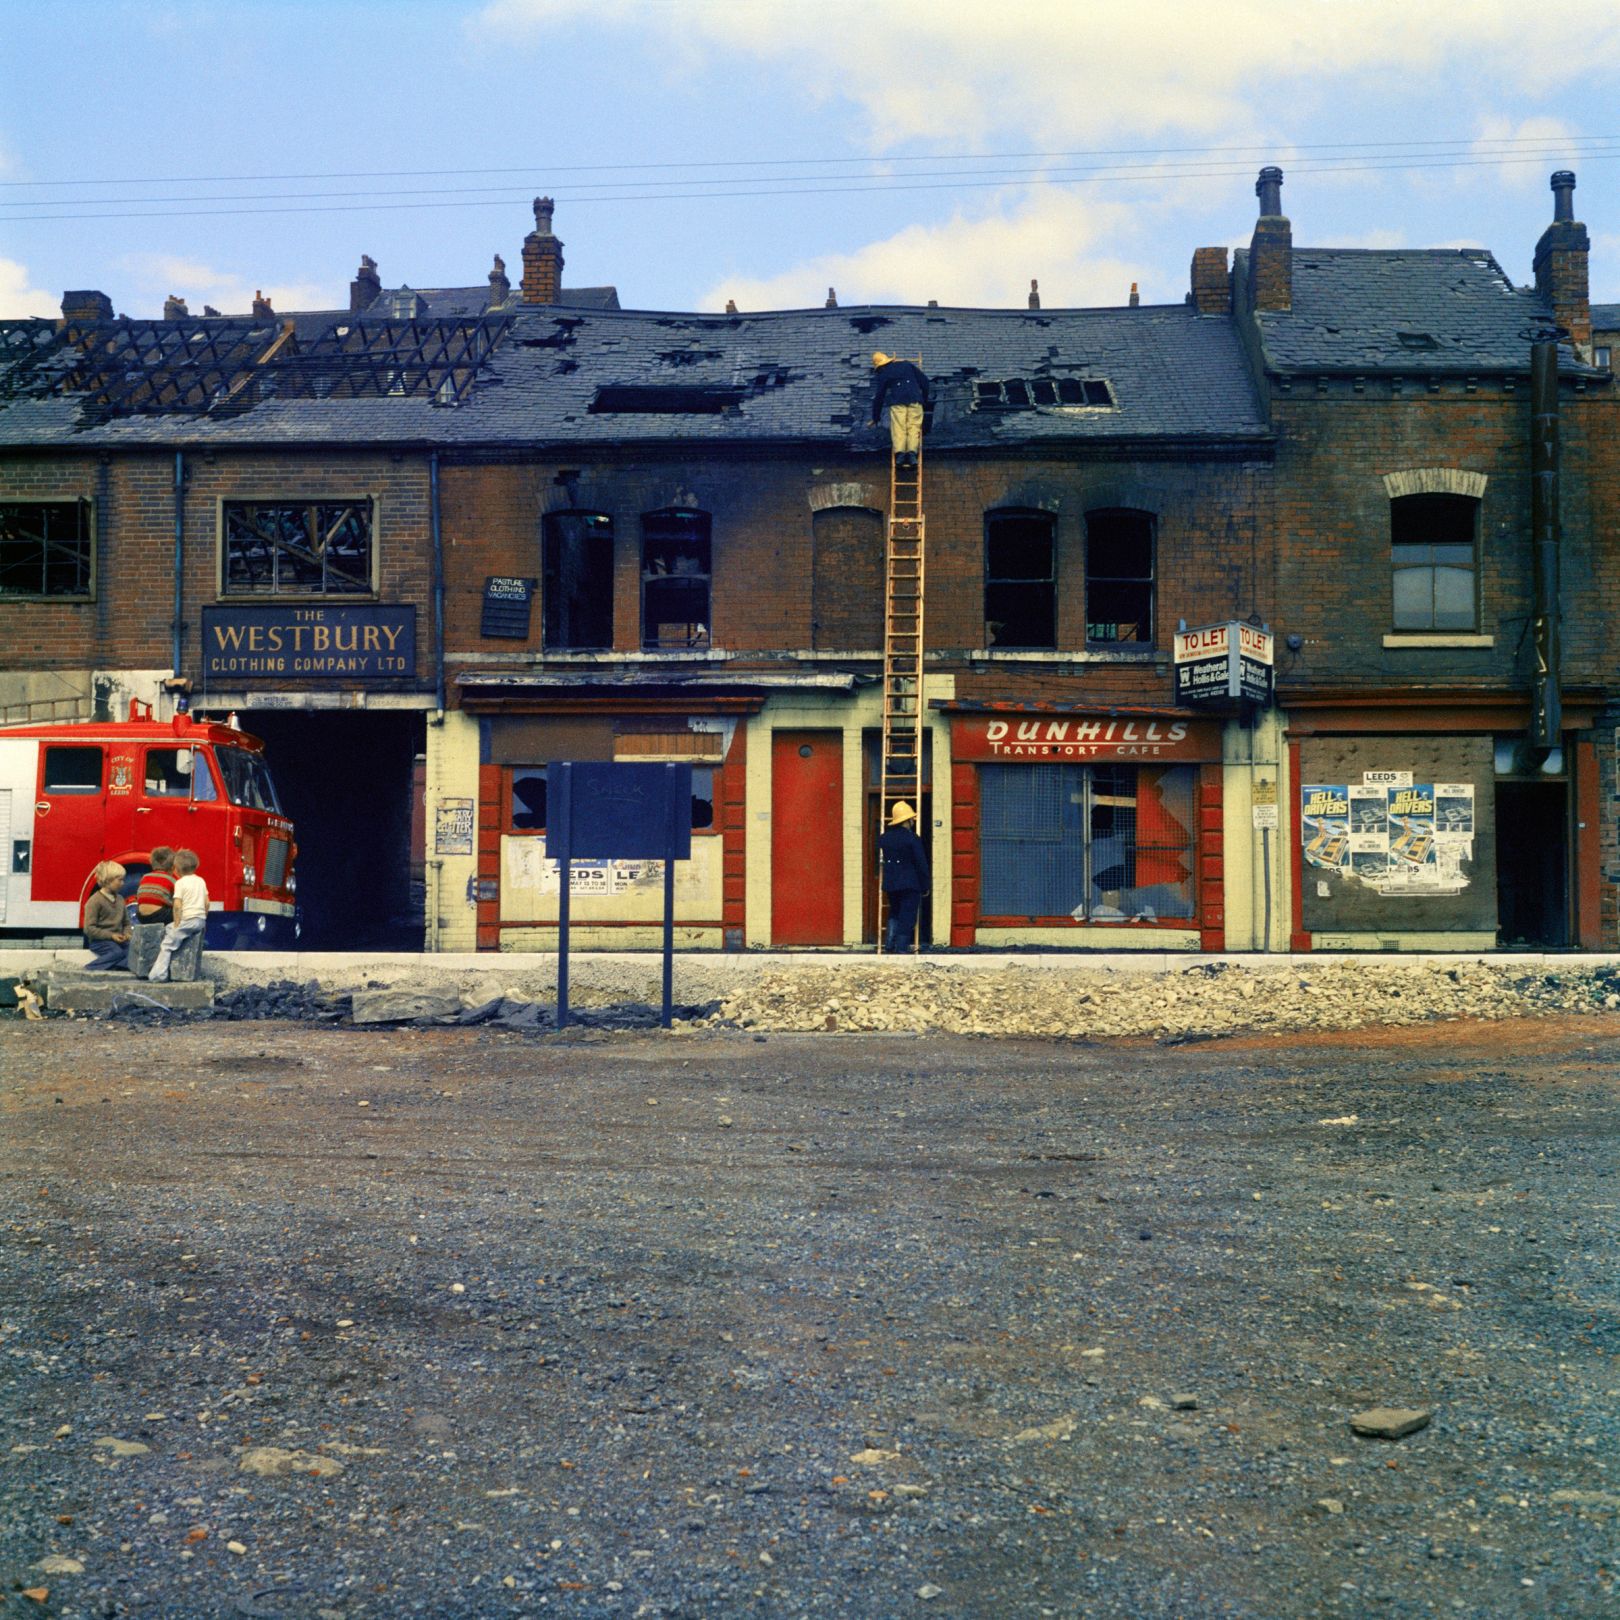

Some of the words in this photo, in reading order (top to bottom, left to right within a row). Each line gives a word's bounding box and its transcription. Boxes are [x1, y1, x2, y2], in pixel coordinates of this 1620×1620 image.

[492, 578, 523, 586] PASTURE
[295, 610, 325, 621] THE
[214, 626, 404, 650] WESTBURY
[1183, 633, 1199, 651] TO
[1202, 627, 1226, 647] LET
[1241, 628, 1251, 645] TO
[1252, 632, 1267, 651] LET
[212, 658, 285, 671] CLOTHING
[295, 658, 368, 671] COMPANY
[378, 657, 406, 670] LTD
[987, 720, 1188, 741] DUNHILLS
[989, 742, 1098, 754] TRANSORT
[1117, 746, 1160, 755] CAFE
[1366, 773, 1397, 781] LEEDS
[1310, 790, 1334, 804] HELL
[1395, 789, 1420, 803] HELL
[1304, 801, 1348, 815] DRIVERS
[1389, 800, 1433, 814] DRIVERS
